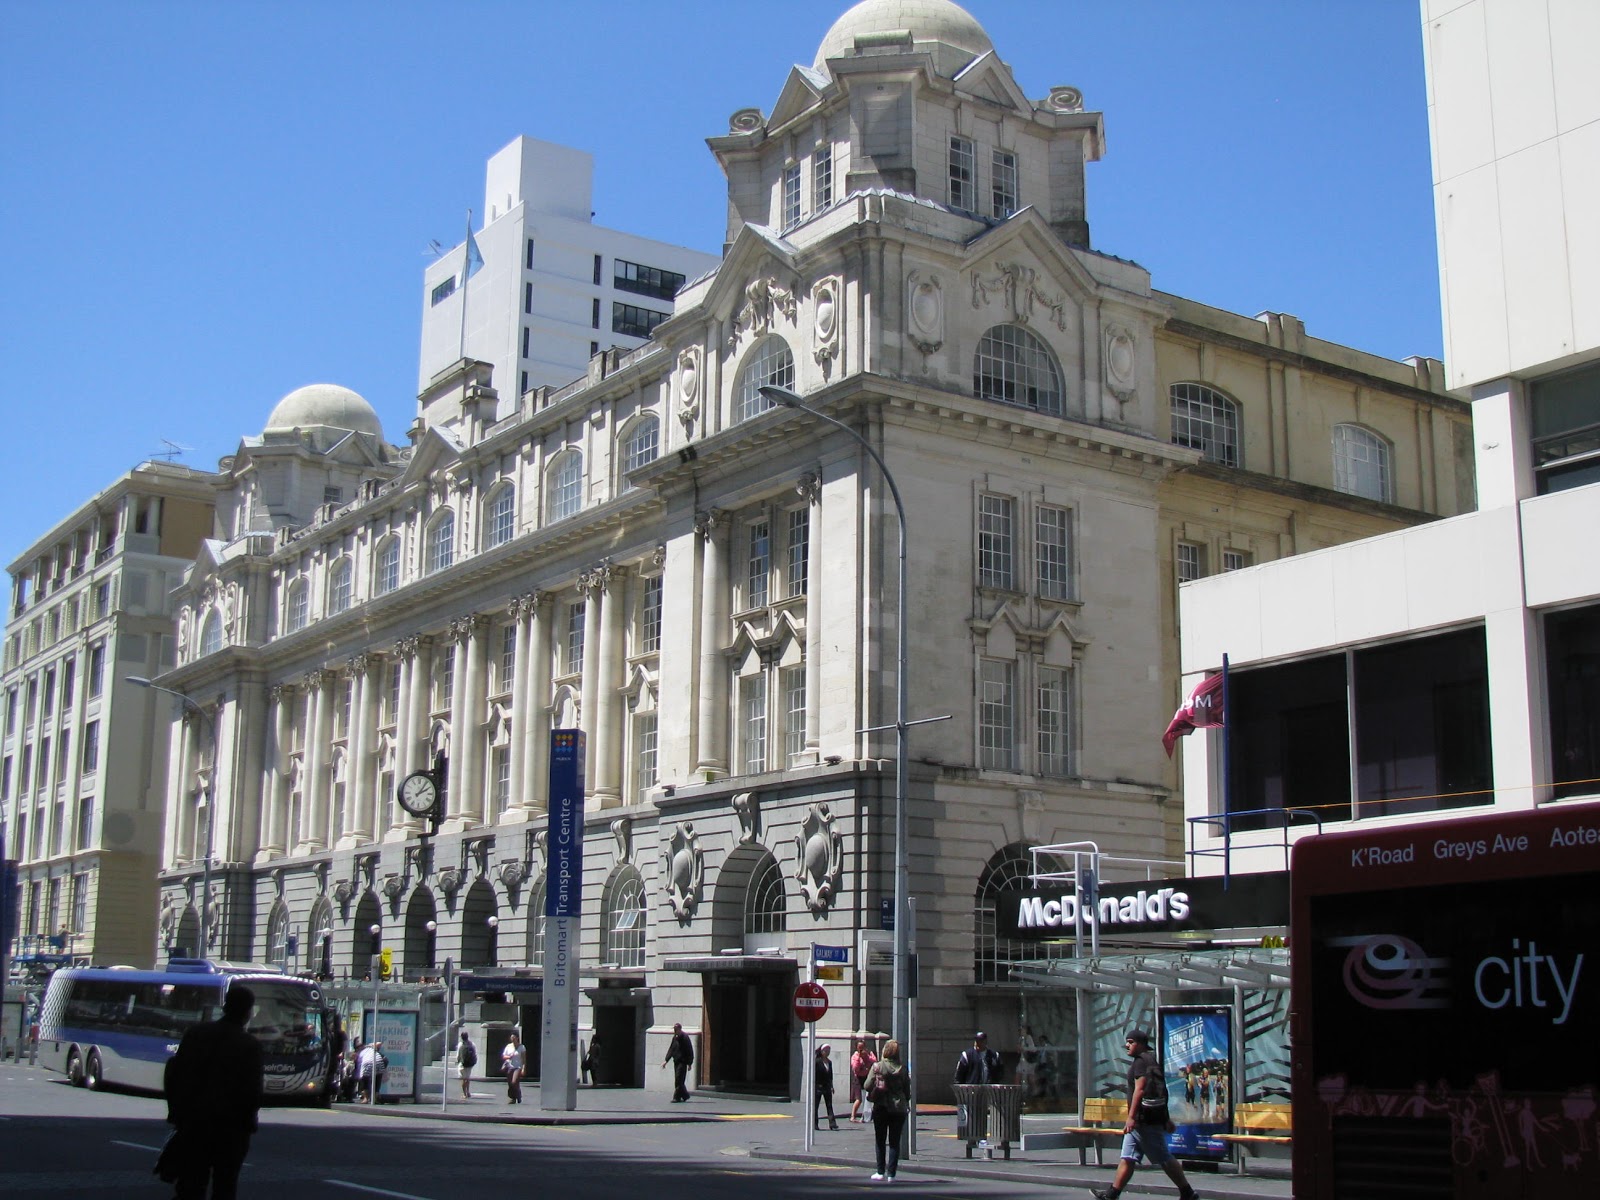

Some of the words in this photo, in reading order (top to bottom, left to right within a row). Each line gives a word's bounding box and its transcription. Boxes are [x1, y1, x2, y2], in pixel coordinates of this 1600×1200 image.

[559, 798, 571, 844] Centre
[1351, 844, 1414, 867] K'Road
[1433, 839, 1487, 861] Greys
[1492, 834, 1528, 853] Ave
[556, 848, 571, 916] Transport
[1018, 888, 1190, 928] McDnald's
[554, 918, 567, 987] Britomart
[1474, 938, 1584, 1024] city
